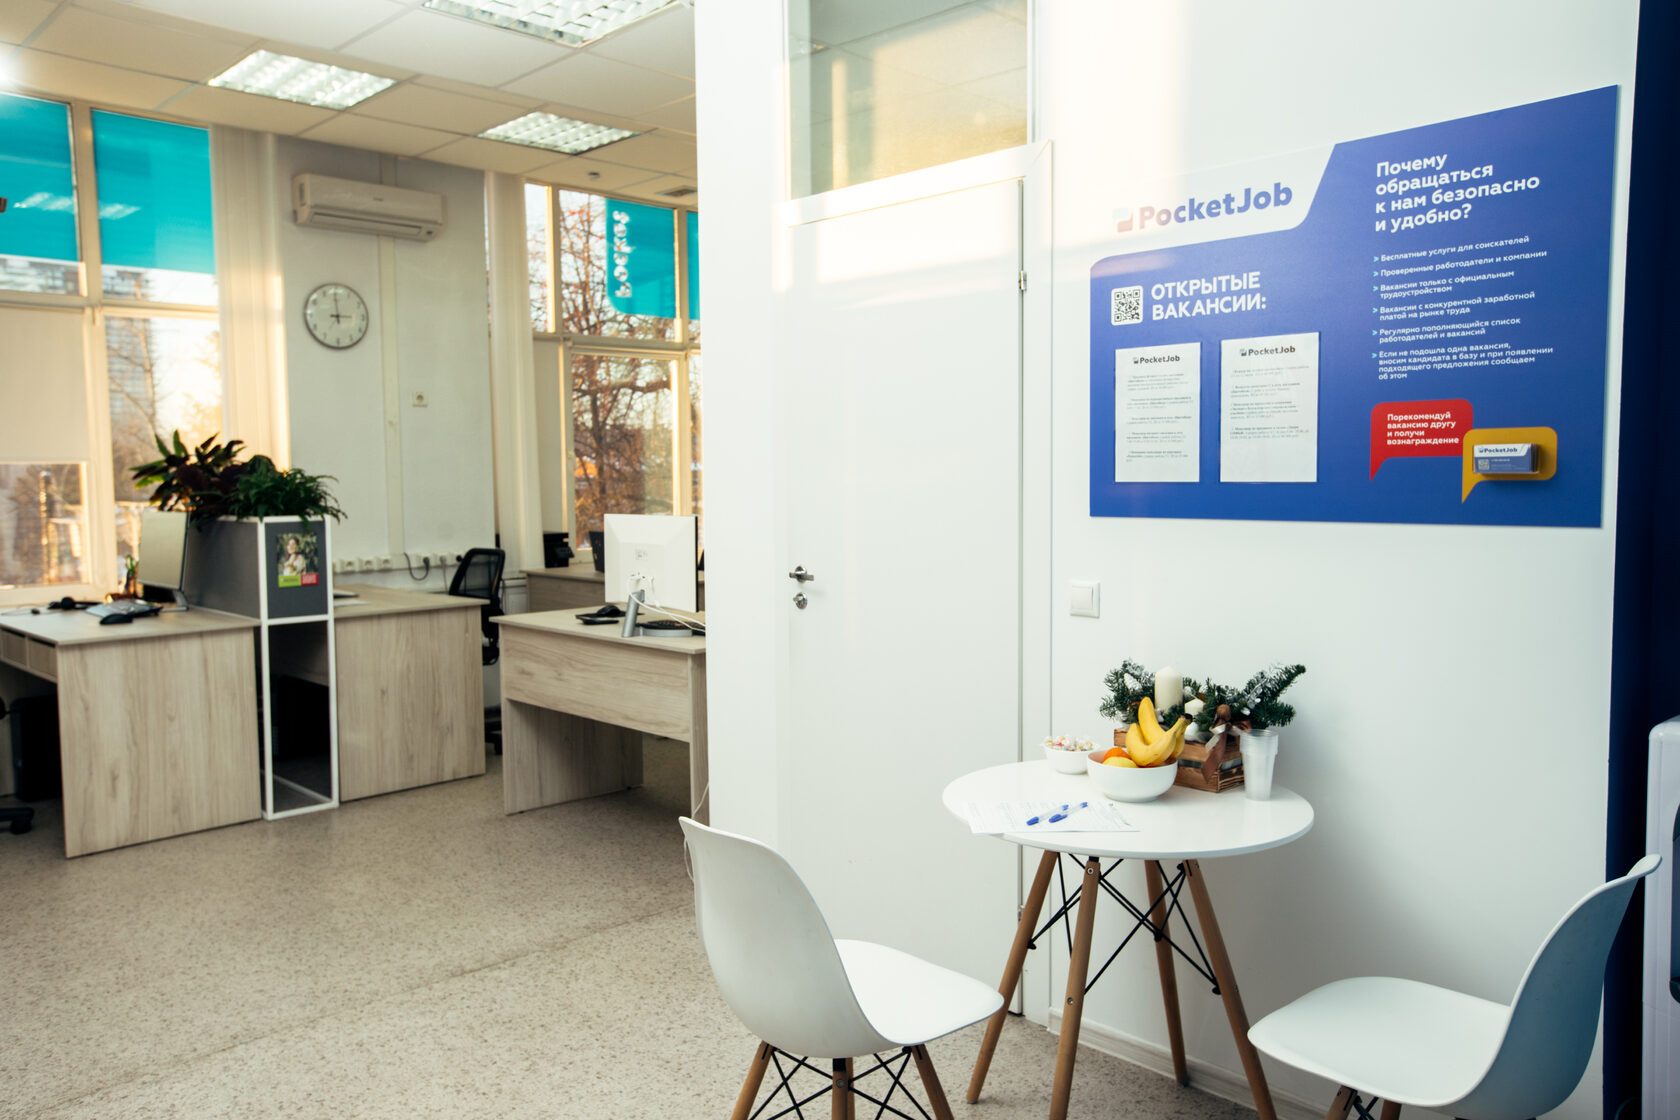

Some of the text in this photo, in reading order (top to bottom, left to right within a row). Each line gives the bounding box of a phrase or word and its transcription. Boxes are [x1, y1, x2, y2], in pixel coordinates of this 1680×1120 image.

[1376, 154, 1448, 177] Почему
[1375, 165, 1494, 195] обращаться
[1375, 176, 1540, 214] к нам безопасно
[1139, 182, 1293, 230] PocketJob
[1375, 203, 1472, 233] и удобно?
[1381, 235, 1529, 262] Бесплатные услуги для соискателей
[1380, 264, 1434, 277] Проверенные
[1435, 257, 1494, 271] работодатели
[1503, 251, 1547, 262] компании
[1151, 271, 1261, 301] ОТКРЫТЫЕ
[1380, 281, 1418, 291] Вакансии
[1419, 278, 1446, 287] только
[1454, 270, 1515, 284] официальным
[1379, 285, 1452, 300] трудоустройством
[1152, 293, 1267, 321] ВАКАНСИИ:
[1379, 304, 1417, 314] Вакансии
[1424, 297, 1482, 310] конкурентной
[1483, 291, 1535, 304] заработной
[1379, 307, 1470, 321] платой на рынке труда
[1379, 318, 1521, 336] Регулярно пополняющийся список
[1379, 331, 1438, 344] работодателей
[1446, 328, 1486, 338] вакансий
[1248, 345, 1296, 356] PocketJob
[1378, 358, 1407, 366] вносим
[1408, 355, 1451, 364] кандидата
[1458, 352, 1478, 361] базу
[1487, 350, 1504, 359] при
[1505, 347, 1553, 356] появлении
[1409, 347, 1446, 356] подошла
[1446, 345, 1468, 354] одна
[1139, 355, 1180, 365] PocketJob
[1378, 356, 1536, 373] подходящего предложения сообщаем
[1378, 372, 1408, 380] об этом
[1387, 411, 1451, 422] Порекомендуй
[1387, 420, 1456, 431] вакансию другу
[1386, 437, 1460, 446] вознаграждение
[1394, 429, 1425, 438] получи
